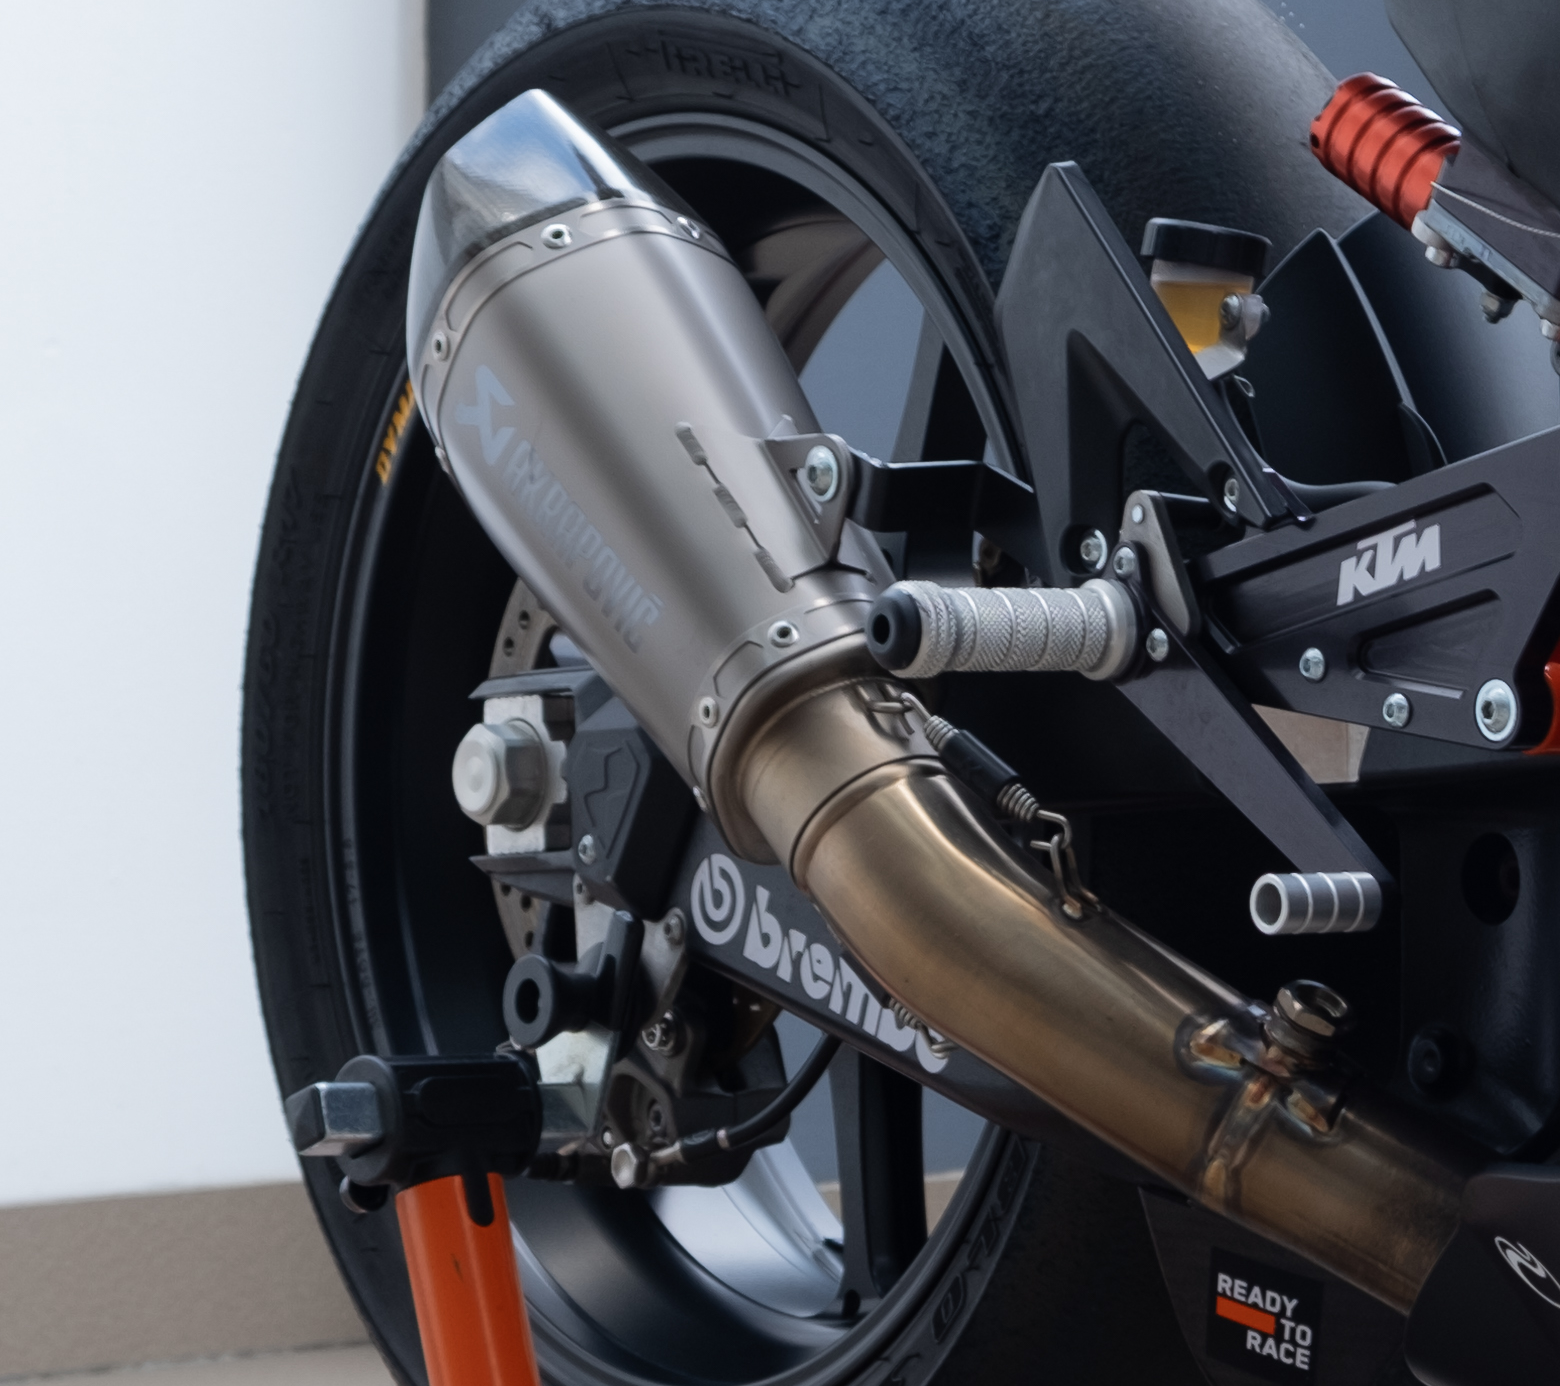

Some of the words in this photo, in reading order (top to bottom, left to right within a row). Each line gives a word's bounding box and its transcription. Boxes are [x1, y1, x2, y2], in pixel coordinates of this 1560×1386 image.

[1336, 518, 1441, 606] KTM
[1217, 1271, 1299, 1318] READY
[1246, 1328, 1312, 1371] RACE
[1279, 1318, 1313, 1347] TO
